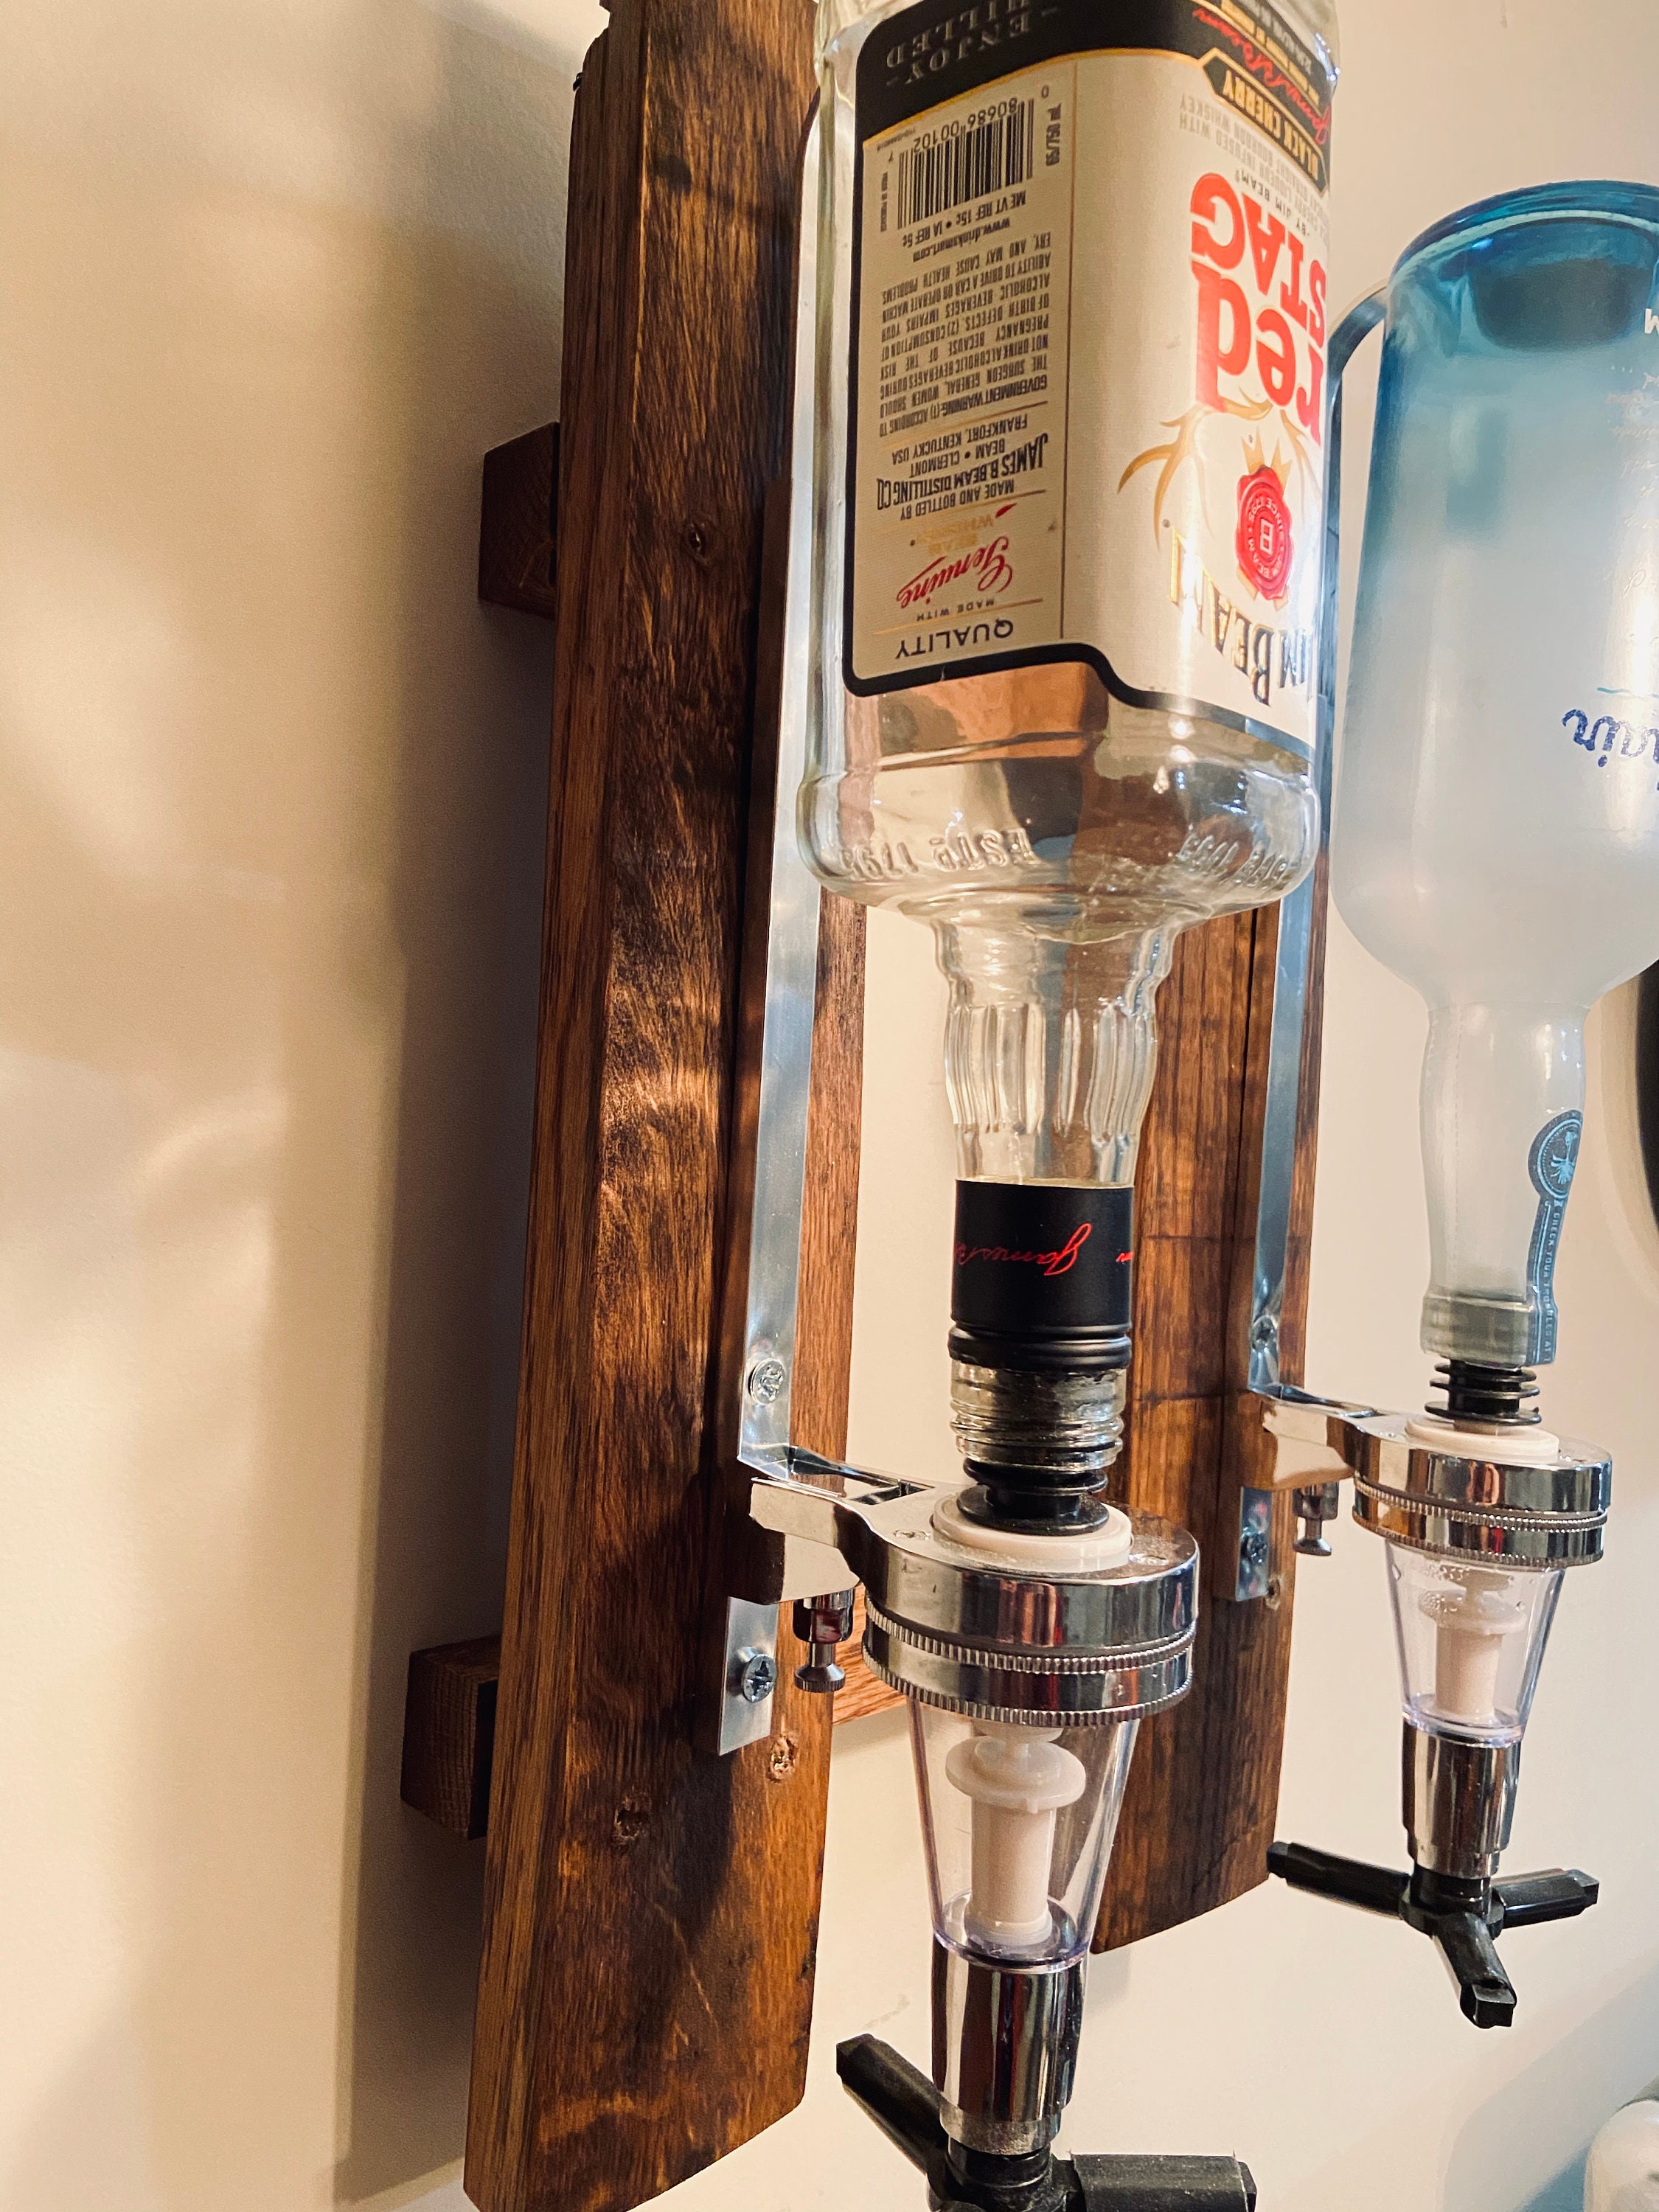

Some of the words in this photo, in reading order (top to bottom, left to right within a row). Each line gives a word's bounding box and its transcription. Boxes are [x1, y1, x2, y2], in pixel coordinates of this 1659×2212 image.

[905, 13, 1029, 84] ENJOY
[967, 97, 1018, 128] 80686
[1222, 70, 1281, 139] CHERRY
[913, 120, 959, 153] 00102
[1284, 119, 1318, 181] BLACK
[995, 197, 1008, 214] VT
[1011, 189, 1026, 209] ME
[975, 201, 992, 221] REF
[913, 218, 1010, 262] www.drinksmart.com
[914, 226, 931, 243] REF
[985, 246, 1003, 265] MAY
[1009, 238, 1026, 257] AND
[956, 254, 980, 276] CAUSE
[1005, 262, 1015, 279] TO
[1017, 251, 1051, 275] ABILITY
[1189, 173, 1326, 349] STAG
[923, 265, 950, 288] HEALTH
[955, 277, 970, 295] CAR
[972, 274, 978, 290] A
[980, 265, 1003, 288] DRIVE
[1000, 272, 1050, 301] ALCOHOLIC
[945, 289, 993, 319] BEVERAGES
[1008, 296, 1035, 318] BIRTH
[1037, 292, 1049, 310] OF
[906, 308, 939, 333] IMPAIRS
[947, 318, 959, 336] (2)
[995, 313, 1049, 341] PREGNANCY
[881, 322, 900, 343] YOUR
[890, 324, 946, 358] CONSUMPTION
[948, 332, 985, 356] BECAUSE
[1032, 334, 1048, 352] NOT
[881, 345, 890, 362] OF
[928, 347, 939, 363] OF
[955, 345, 1002, 373] ALCOHOLIC
[1003, 338, 1029, 358] DRINK
[1190, 260, 1324, 448] red
[880, 361, 897, 381] RISK
[905, 353, 919, 372] THE
[987, 358, 1026, 384] SURGEON
[1032, 353, 1047, 372] THE
[908, 361, 954, 389] BEVERAGES
[880, 376, 908, 400] DURING
[911, 384, 939, 407] WOMEN
[984, 374, 1048, 404] GOVERNMENT
[891, 447, 909, 465] USA
[913, 431, 961, 459] KENTUCKY
[975, 438, 1005, 459] BEAM
[1001, 433, 1048, 476] JAMES
[909, 450, 959, 479] CLERMONT
[953, 462, 987, 487] BEAM
[892, 476, 952, 504] DISTILLING
[959, 485, 981, 505] AND
[984, 479, 1015, 498] MADE
[900, 505, 912, 521] BY
[915, 493, 956, 517] BOTTLED
[896, 536, 1013, 609] Genuine
[917, 608, 950, 622] WITH
[957, 598, 995, 613] MADE
[895, 619, 1013, 659] QUALITY
[1561, 708, 1659, 793] air
